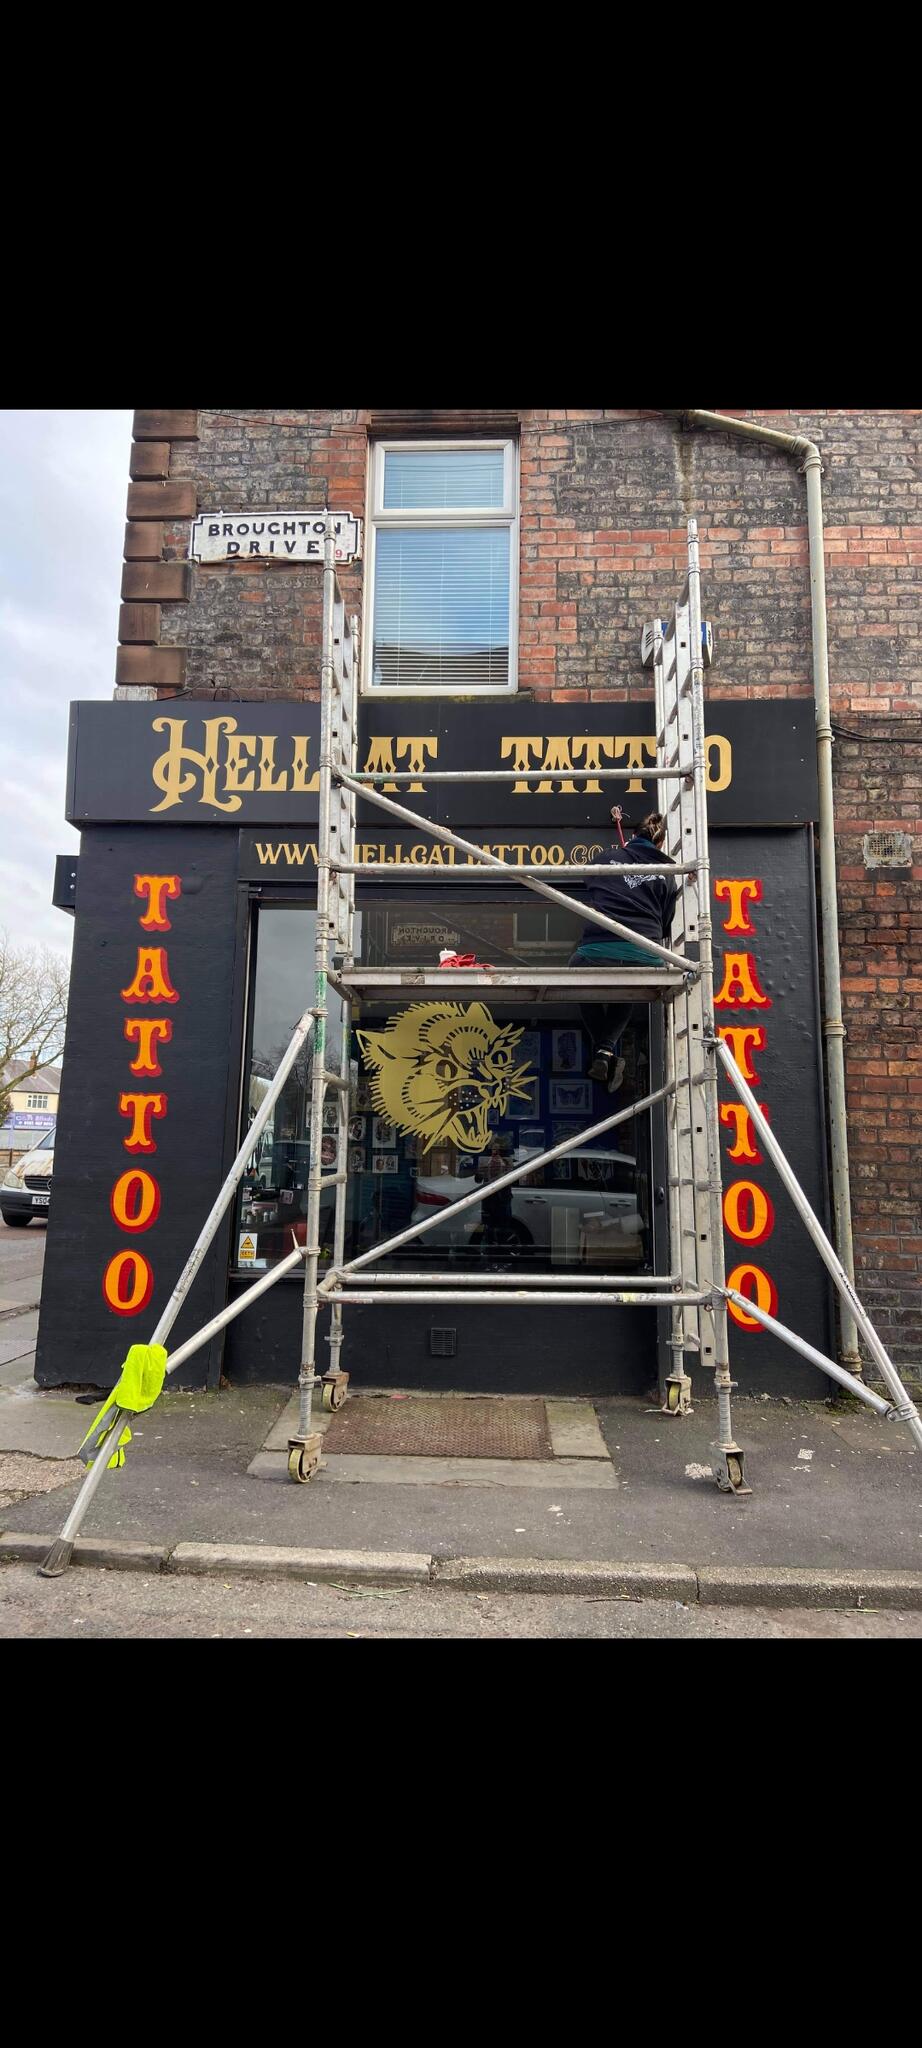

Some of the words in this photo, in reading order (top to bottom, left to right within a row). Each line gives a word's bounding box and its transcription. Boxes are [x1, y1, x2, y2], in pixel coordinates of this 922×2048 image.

[227, 540, 319, 555] DRIVE
[149, 716, 438, 813] HELLAT
[501, 735, 732, 794] TATTO
[102, 873, 182, 1317] TATTOO
[713, 876, 777, 1332] TATTOO
